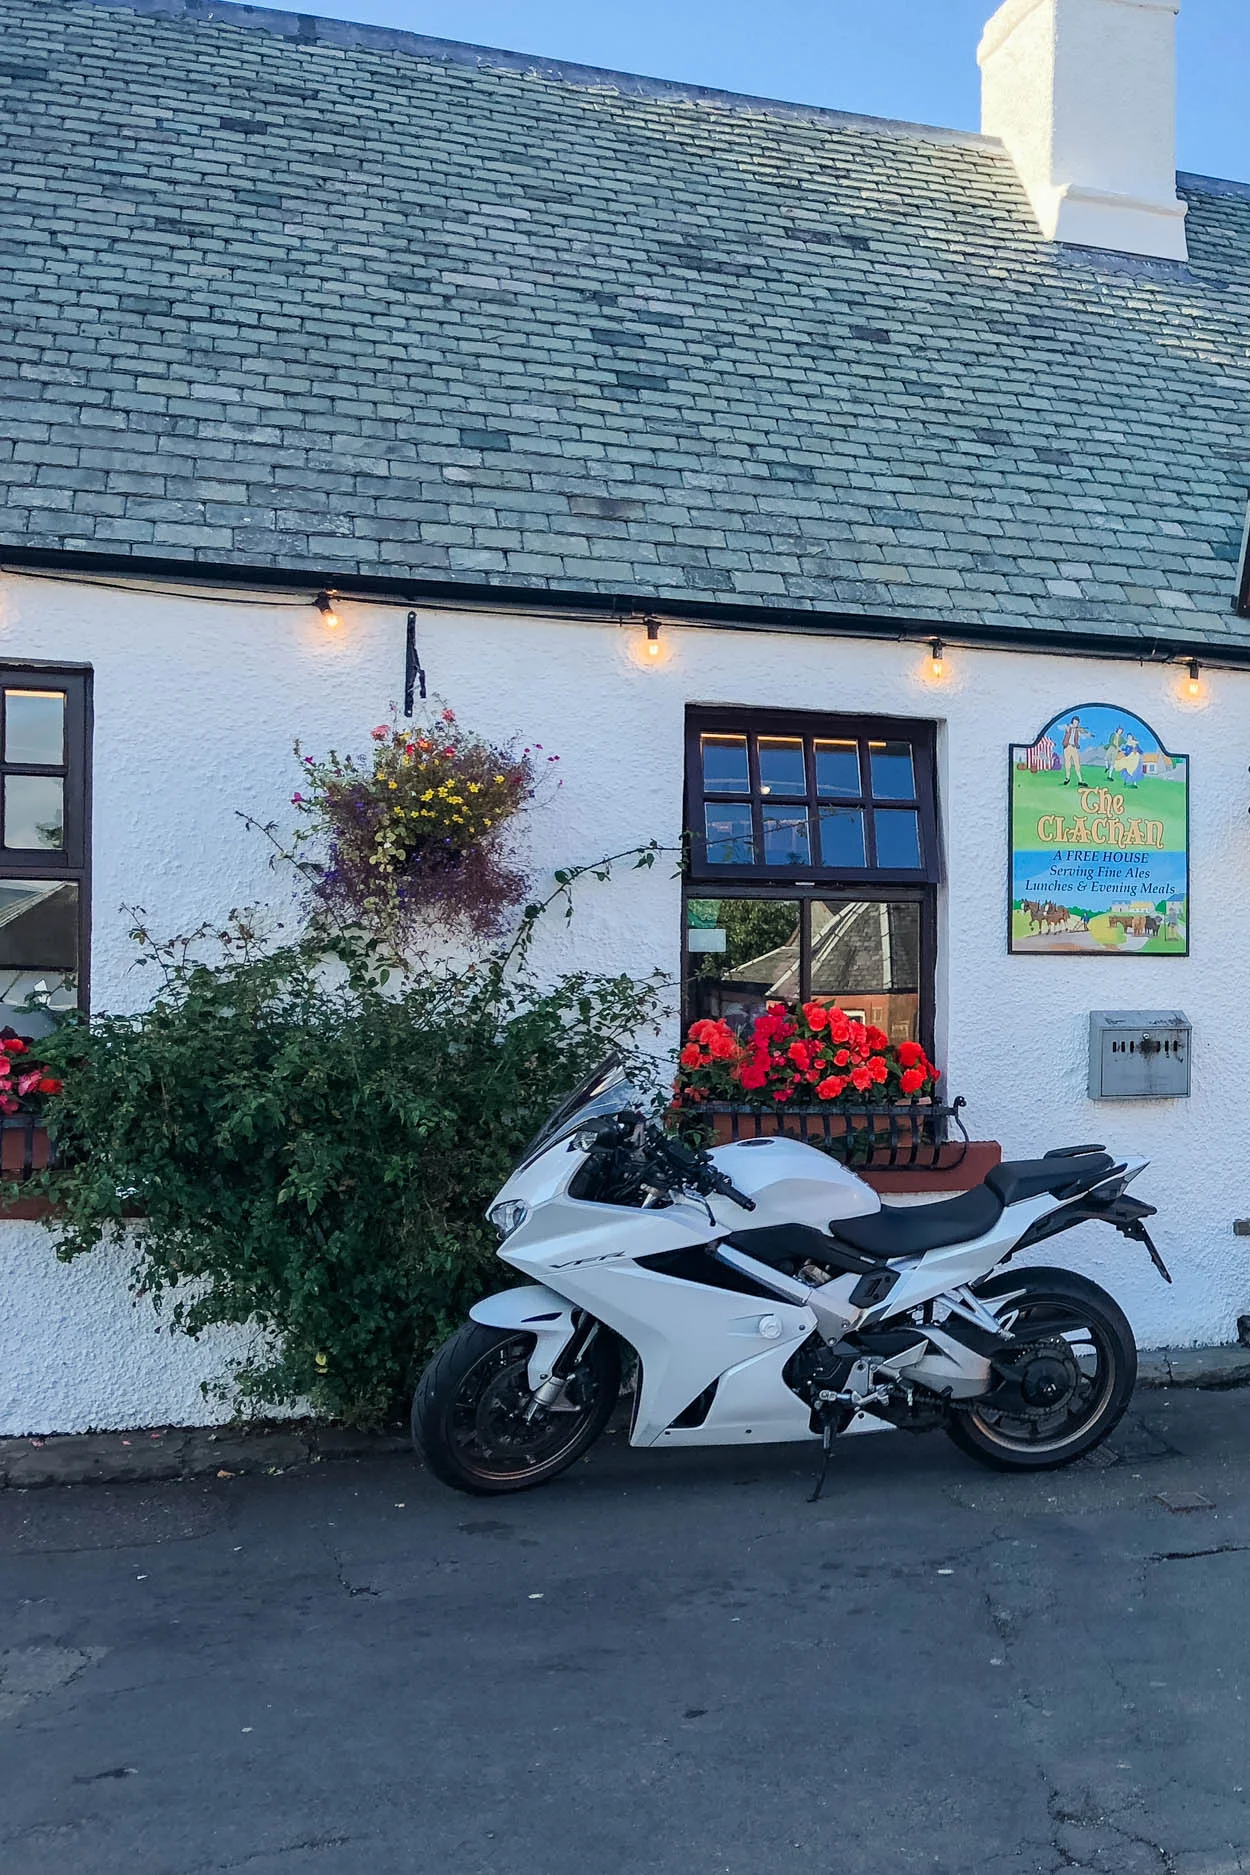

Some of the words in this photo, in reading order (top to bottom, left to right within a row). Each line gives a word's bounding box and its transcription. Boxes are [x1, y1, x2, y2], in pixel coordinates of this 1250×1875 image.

[1077, 786, 1125, 818] The
[1052, 850, 1063, 862] A
[1066, 850, 1100, 862] FREE
[1103, 851, 1150, 864] HOUSE
[1050, 865, 1094, 880] Serving
[1098, 866, 1122, 878] Fine
[1125, 867, 1151, 879] Ales
[1025, 879, 1074, 892] Lunches
[1077, 880, 1088, 893] &
[1091, 881, 1139, 897] Evening
[1140, 882, 1176, 895] Meals
